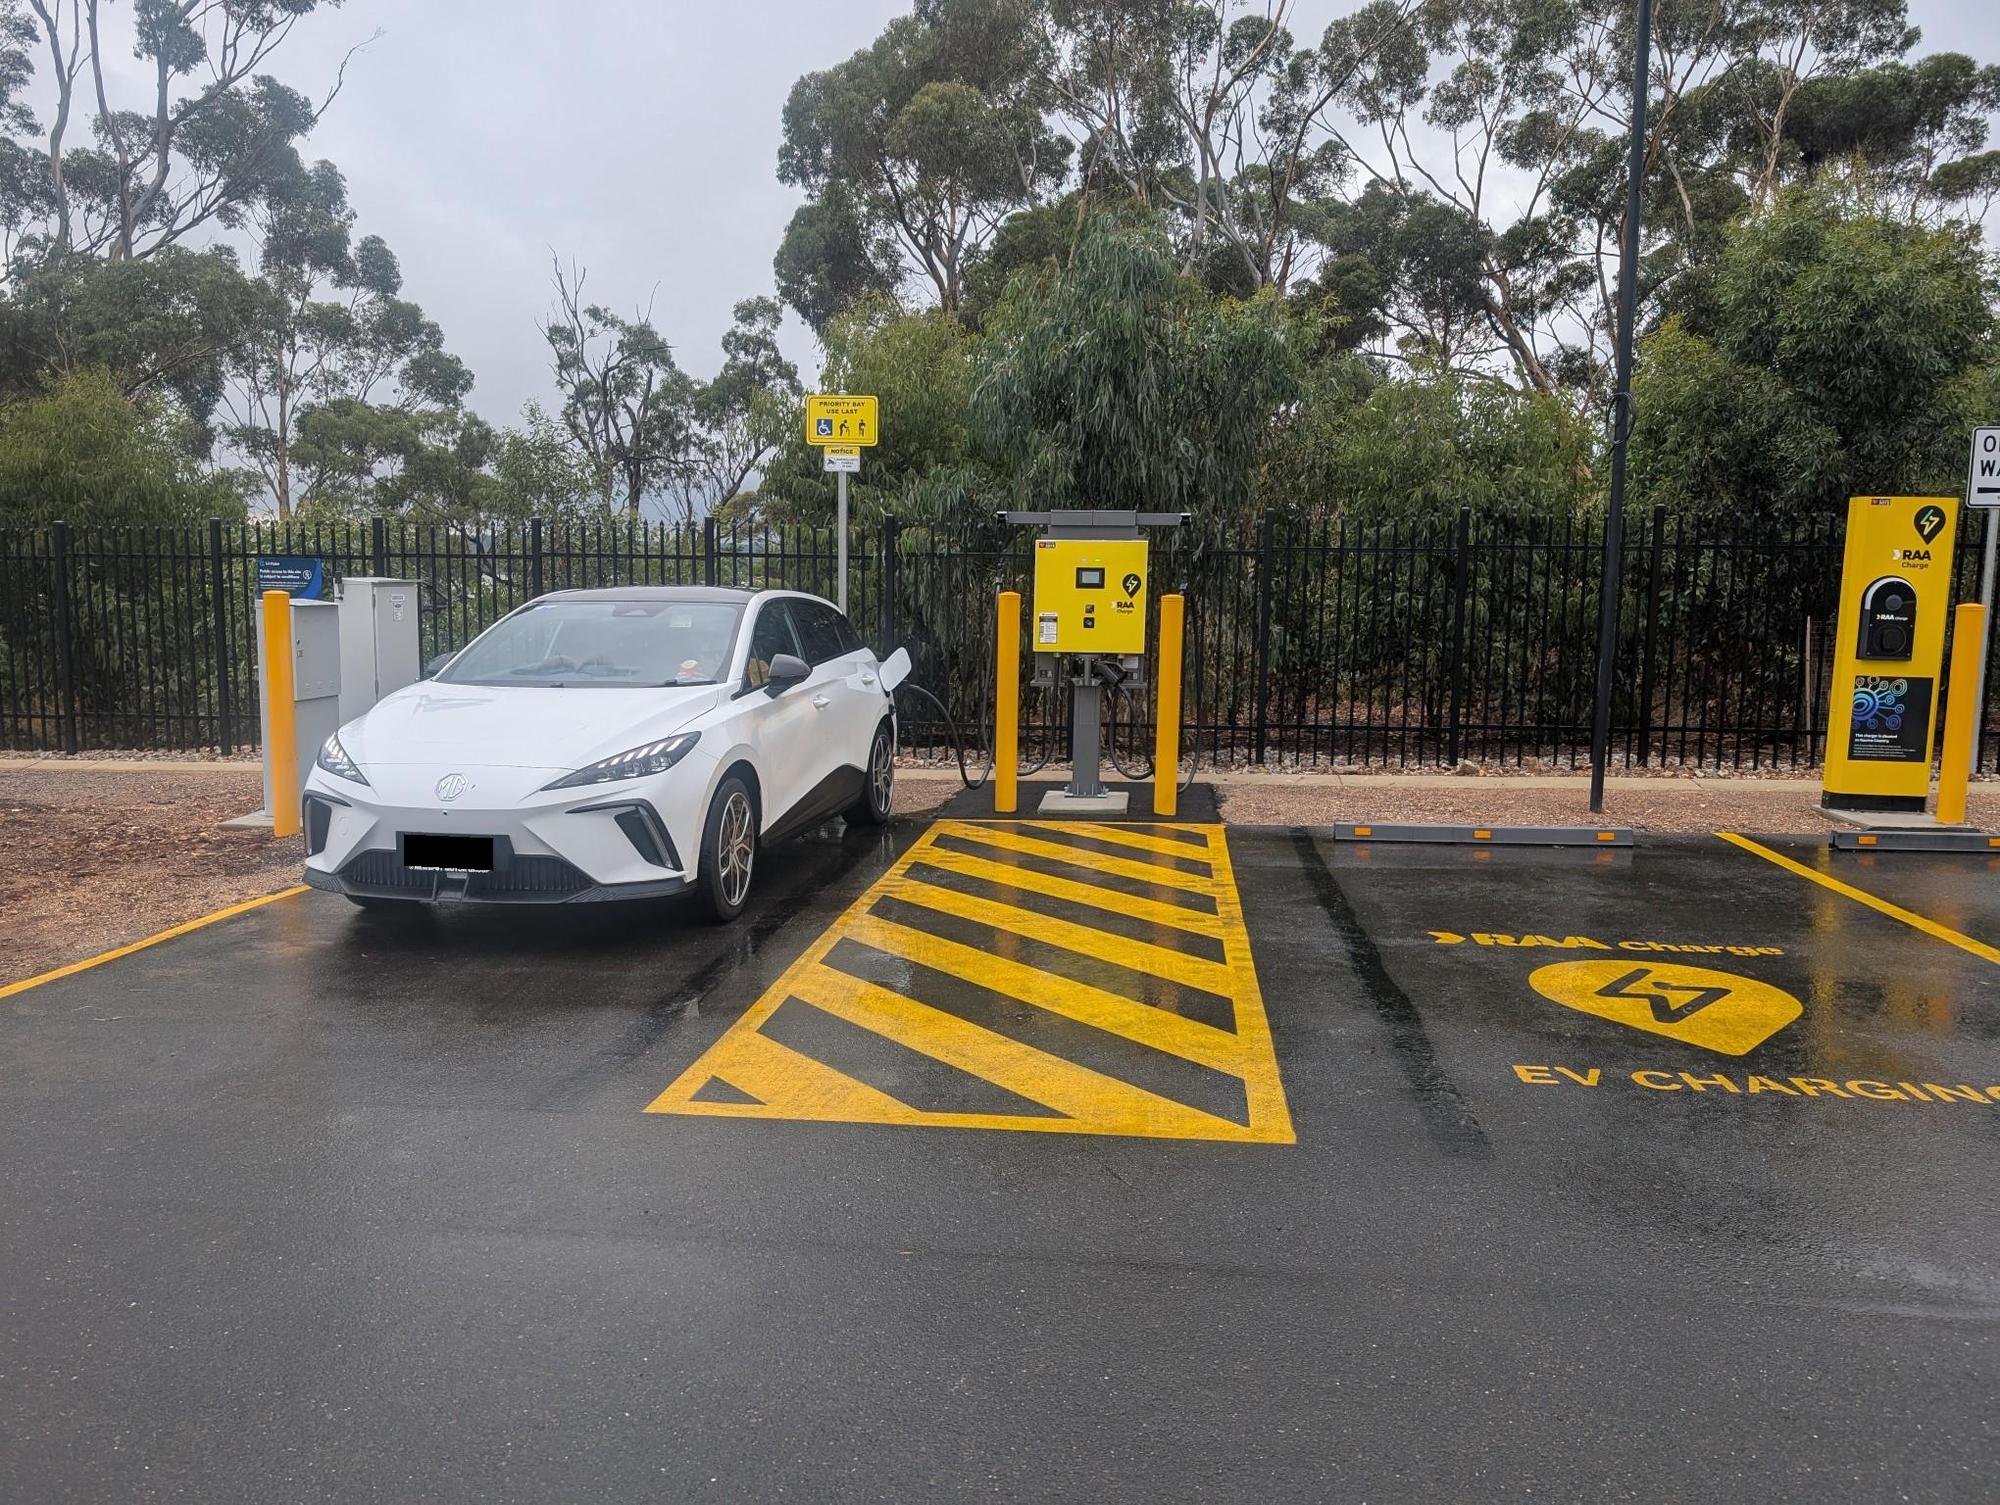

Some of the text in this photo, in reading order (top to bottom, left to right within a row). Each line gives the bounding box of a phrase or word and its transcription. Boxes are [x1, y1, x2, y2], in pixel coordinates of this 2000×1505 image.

[1983, 435, 2000, 453] O
[1981, 460, 2000, 477] W
[1903, 549, 1932, 561] RAA
[1901, 562, 1929, 570] Charge
[1116, 601, 1135, 609] RAA
[437, 774, 467, 800] MG
[1471, 933, 1785, 956] RAA charge
[1512, 1065, 2000, 1104] EV CHARGIN
